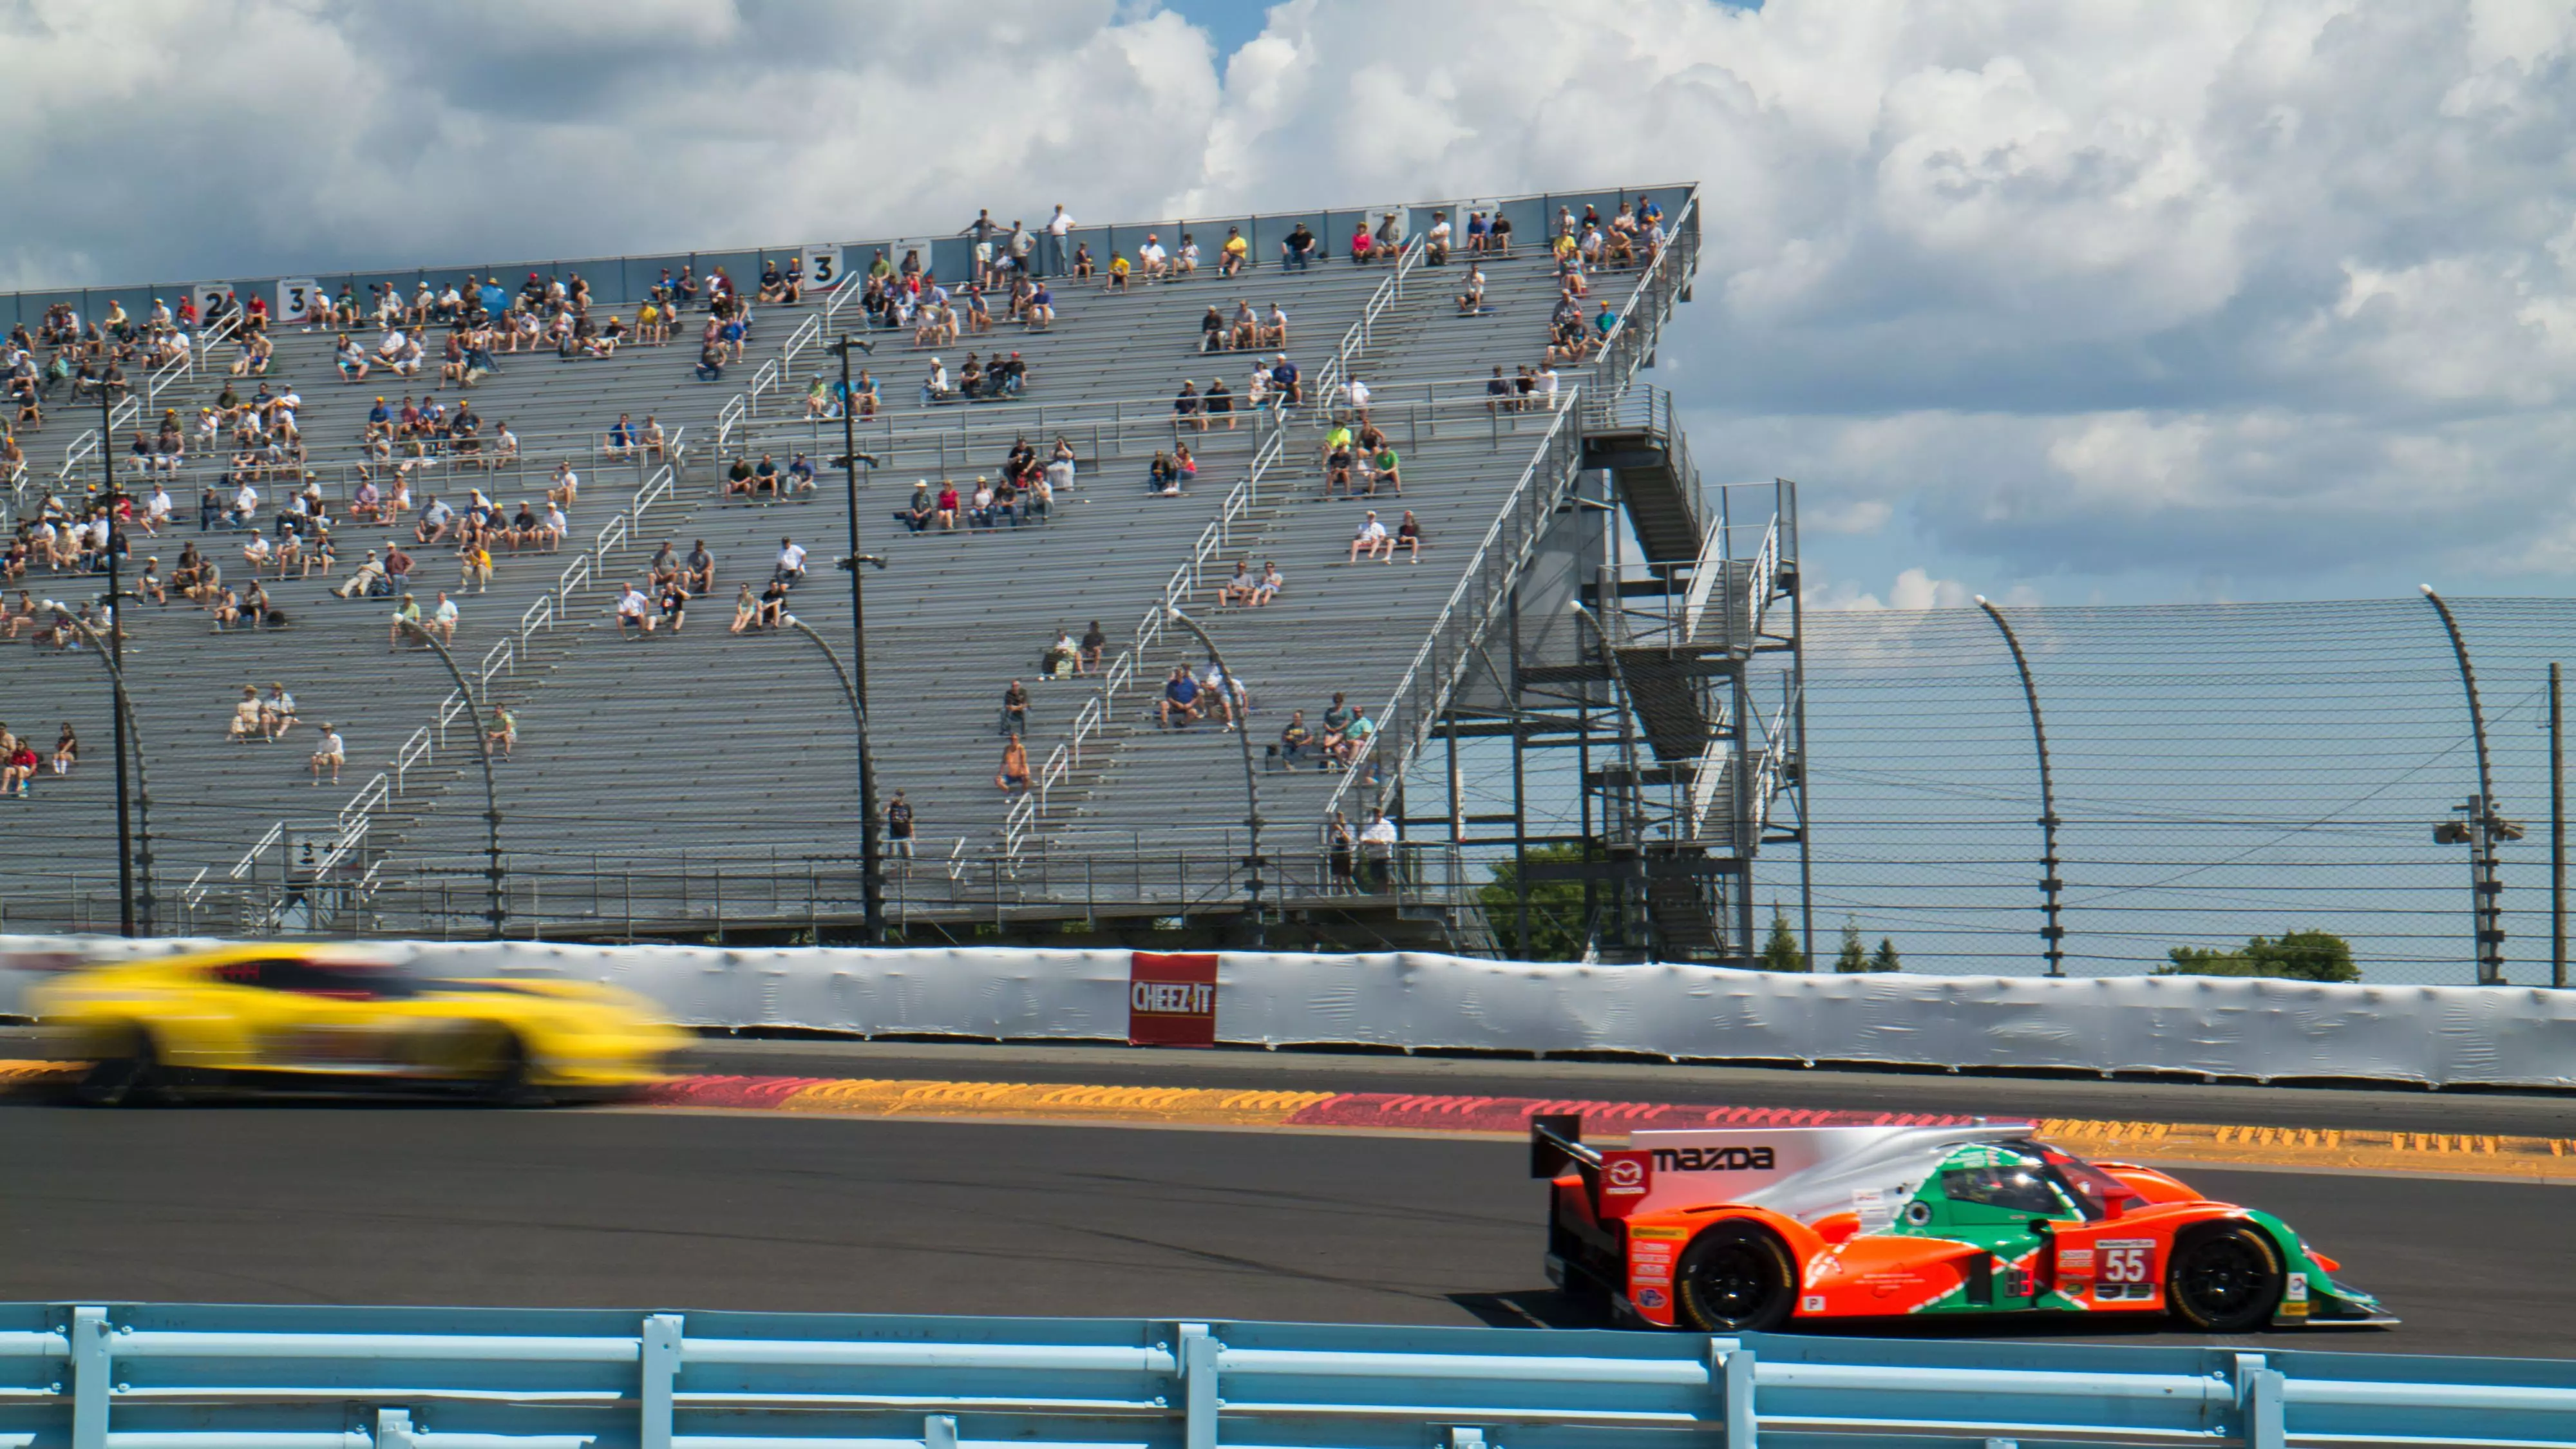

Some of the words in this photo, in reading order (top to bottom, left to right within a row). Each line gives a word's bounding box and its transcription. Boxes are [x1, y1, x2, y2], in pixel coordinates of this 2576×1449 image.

[814, 256, 833, 282] 3
[205, 292, 223, 317] 2
[289, 287, 305, 313] 3
[1651, 1147, 1775, 1171] mazda
[2105, 1249, 2146, 1283] 55
[1809, 1298, 1818, 1309] P
